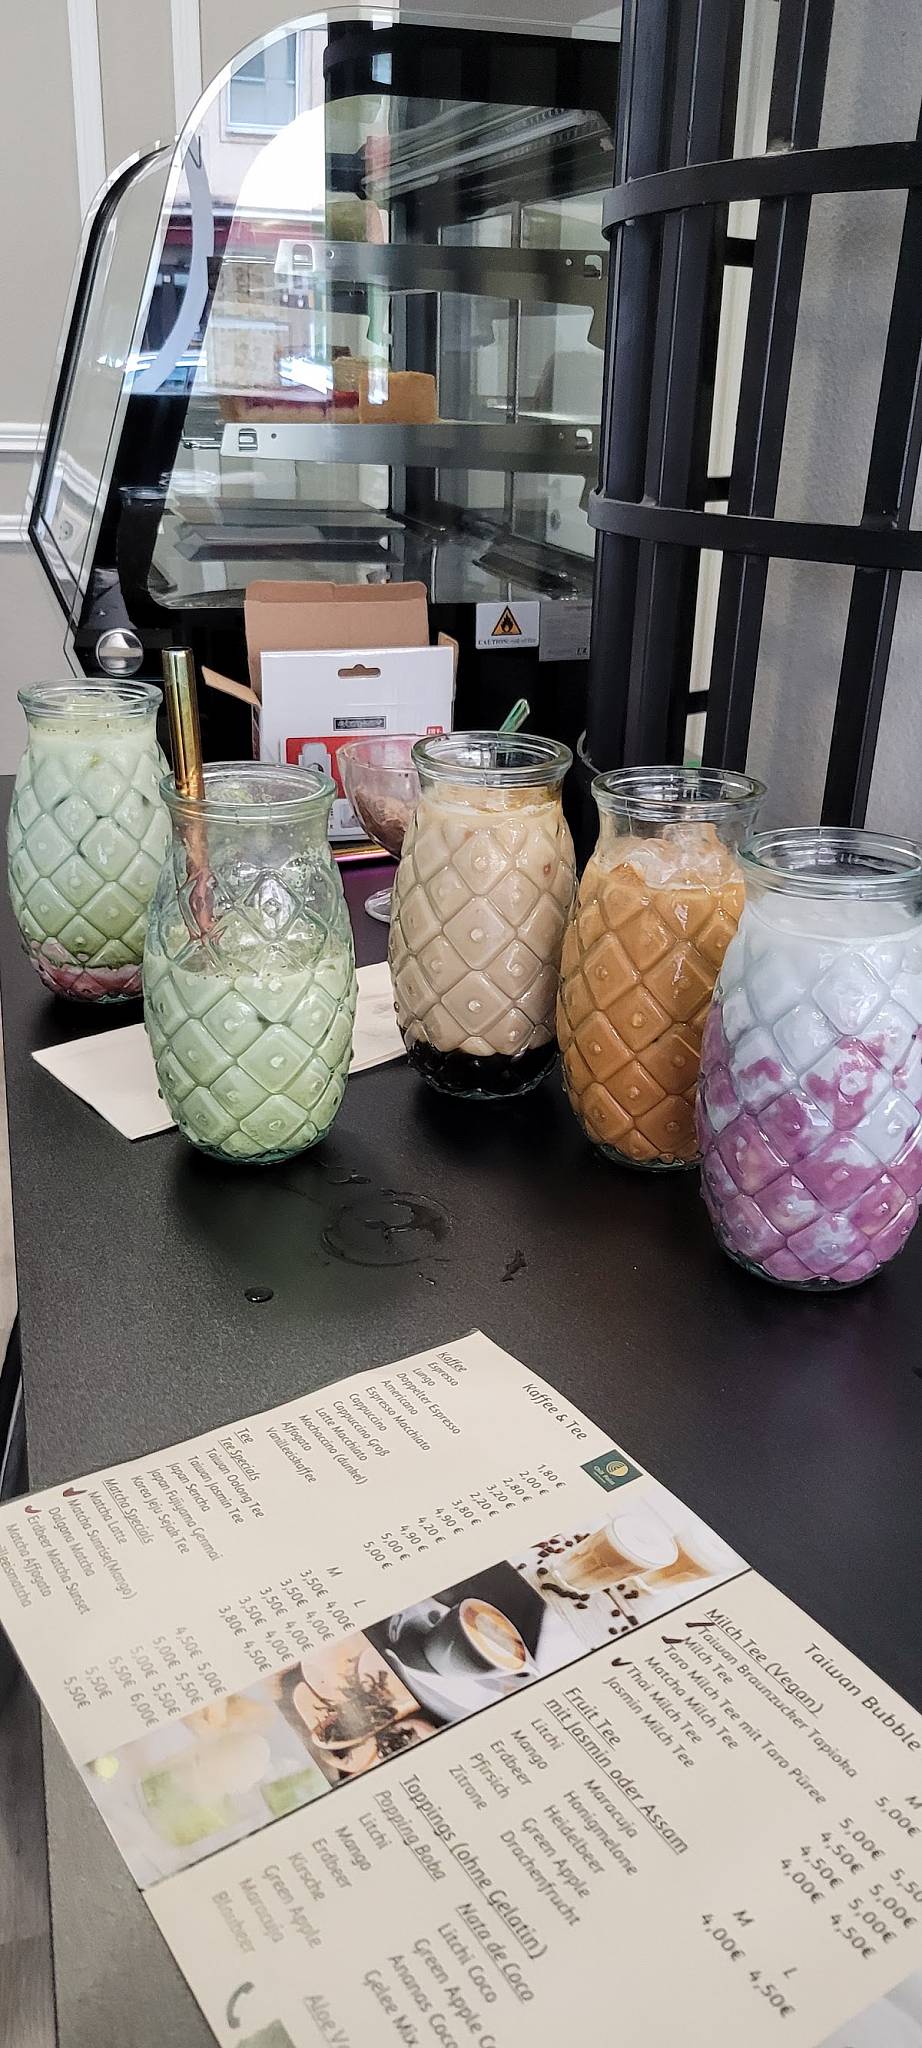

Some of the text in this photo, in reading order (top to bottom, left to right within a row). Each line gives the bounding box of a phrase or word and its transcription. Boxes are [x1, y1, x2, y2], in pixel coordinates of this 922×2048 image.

[410, 1367, 436, 1387] Lungo
[427, 1361, 459, 1387] Espresso
[437, 1351, 468, 1373] Kaffee
[332, 1400, 391, 1457] Cappuccino Groß
[348, 1393, 388, 1432] Cappuccino
[364, 1385, 431, 1451] Espresso Macchiato
[379, 1379, 419, 1416] Americano
[395, 1372, 461, 1435] Doppelter Espresso
[522, 1383, 588, 1440] Kaffee & Tee
[217, 1436, 261, 1482] Tee Specials
[236, 1427, 254, 1444] Tee
[265, 1426, 317, 1484] Vanilleeiskaffee
[280, 1421, 313, 1452] Affogato
[298, 1414, 368, 1485] Mochaccino (dunkel)
[314, 1407, 368, 1462] Latte Macchiato
[102, 1478, 154, 1544] Matcha Specials
[130, 1474, 190, 1555] Korea Jeju Sejak Tee
[146, 1468, 171, 1491] Japan
[165, 1489, 197, 1528] Fujiyama
[165, 1462, 211, 1513] Japan Sencha
[187, 1455, 245, 1525] Taiwan Jasmin Tee
[205, 1447, 265, 1519] Taiwan Oolong Tee
[47, 1506, 96, 1577] Dalgona Matcha
[66, 1498, 138, 1600] Matcha Sunrise(Mango)
[87, 1490, 128, 1545] Matcha Latte
[6, 1523, 52, 1598] Matcha Affogato
[26, 1514, 91, 1616] Erdbeer Matcha Sunset
[238, 1595, 295, 1663] 3,50€ 4,00€
[259, 1586, 315, 1653] 3,50€ 4,00€
[279, 1578, 335, 1642] 3,50€ 4,00€
[299, 1569, 356, 1632] 3,50€ 4,00€
[152, 1636, 205, 1706] 5,00€ 5,50€
[175, 1626, 228, 1697] 4,50€ 5,00€
[218, 1605, 273, 1673] 3,80€ 4,50€
[679, 1636, 733, 1685] Milch Tee
[703, 1608, 824, 1716] Milch Tee (Vegan)
[63, 1675, 91, 1710] 5,50€
[84, 1666, 113, 1701] 5,50€
[108, 1655, 160, 1728] 5,50€ 6,00€
[151, 1682, 182, 1717] 5,50€
[626, 1664, 702, 1744] Thai Milch Tee
[644, 1655, 739, 1750] Matcha Milch Tee
[697, 1625, 857, 1778] Taiwan Braunzucker Tapioka
[804, 1642, 921, 1752] Taiwan Bubble
[510, 1729, 549, 1770] Mango
[530, 1718, 565, 1751] Litchi
[562, 1686, 621, 1748] Fruit Tee
[601, 1676, 695, 1768] Jasmin Milch Tee
[663, 1644, 827, 1804] Taro Milch Tee mit Taro Püree
[448, 1763, 488, 1812] Zitrone
[469, 1752, 511, 1799] Pfirsich
[489, 1739, 533, 1786] Erdbeer
[543, 1698, 688, 1856] mit Jasmin oder Assam
[357, 1811, 393, 1851] Litchi
[375, 1789, 447, 1882] Popping Boba
[543, 1804, 606, 1874] Heidelbeer
[562, 1789, 638, 1876] Honigmelone
[583, 1778, 638, 1839] Maracuja
[839, 1817, 886, 1862] 5,00€
[874, 1796, 921, 1838] 5,00€
[287, 1851, 326, 1902] Kirsche
[311, 1837, 353, 1889] Erdbeer
[334, 1824, 372, 1872] Mango
[399, 1773, 548, 1960] Toppings (ohne Gelatin)
[499, 1829, 581, 1927] Drachenfrucht
[520, 1817, 591, 1899] Green Apple
[820, 1832, 918, 1929] 4,50€ 5,00€
[780, 1858, 876, 1959] 4,00€ 4,50€
[799, 1845, 897, 1944] 4,50€ 5,00€
[437, 1922, 498, 2004] Litchi Coco
[455, 1902, 535, 2004] Nata de Coco
[701, 1913, 796, 2018] 4,00€ 4,50€
